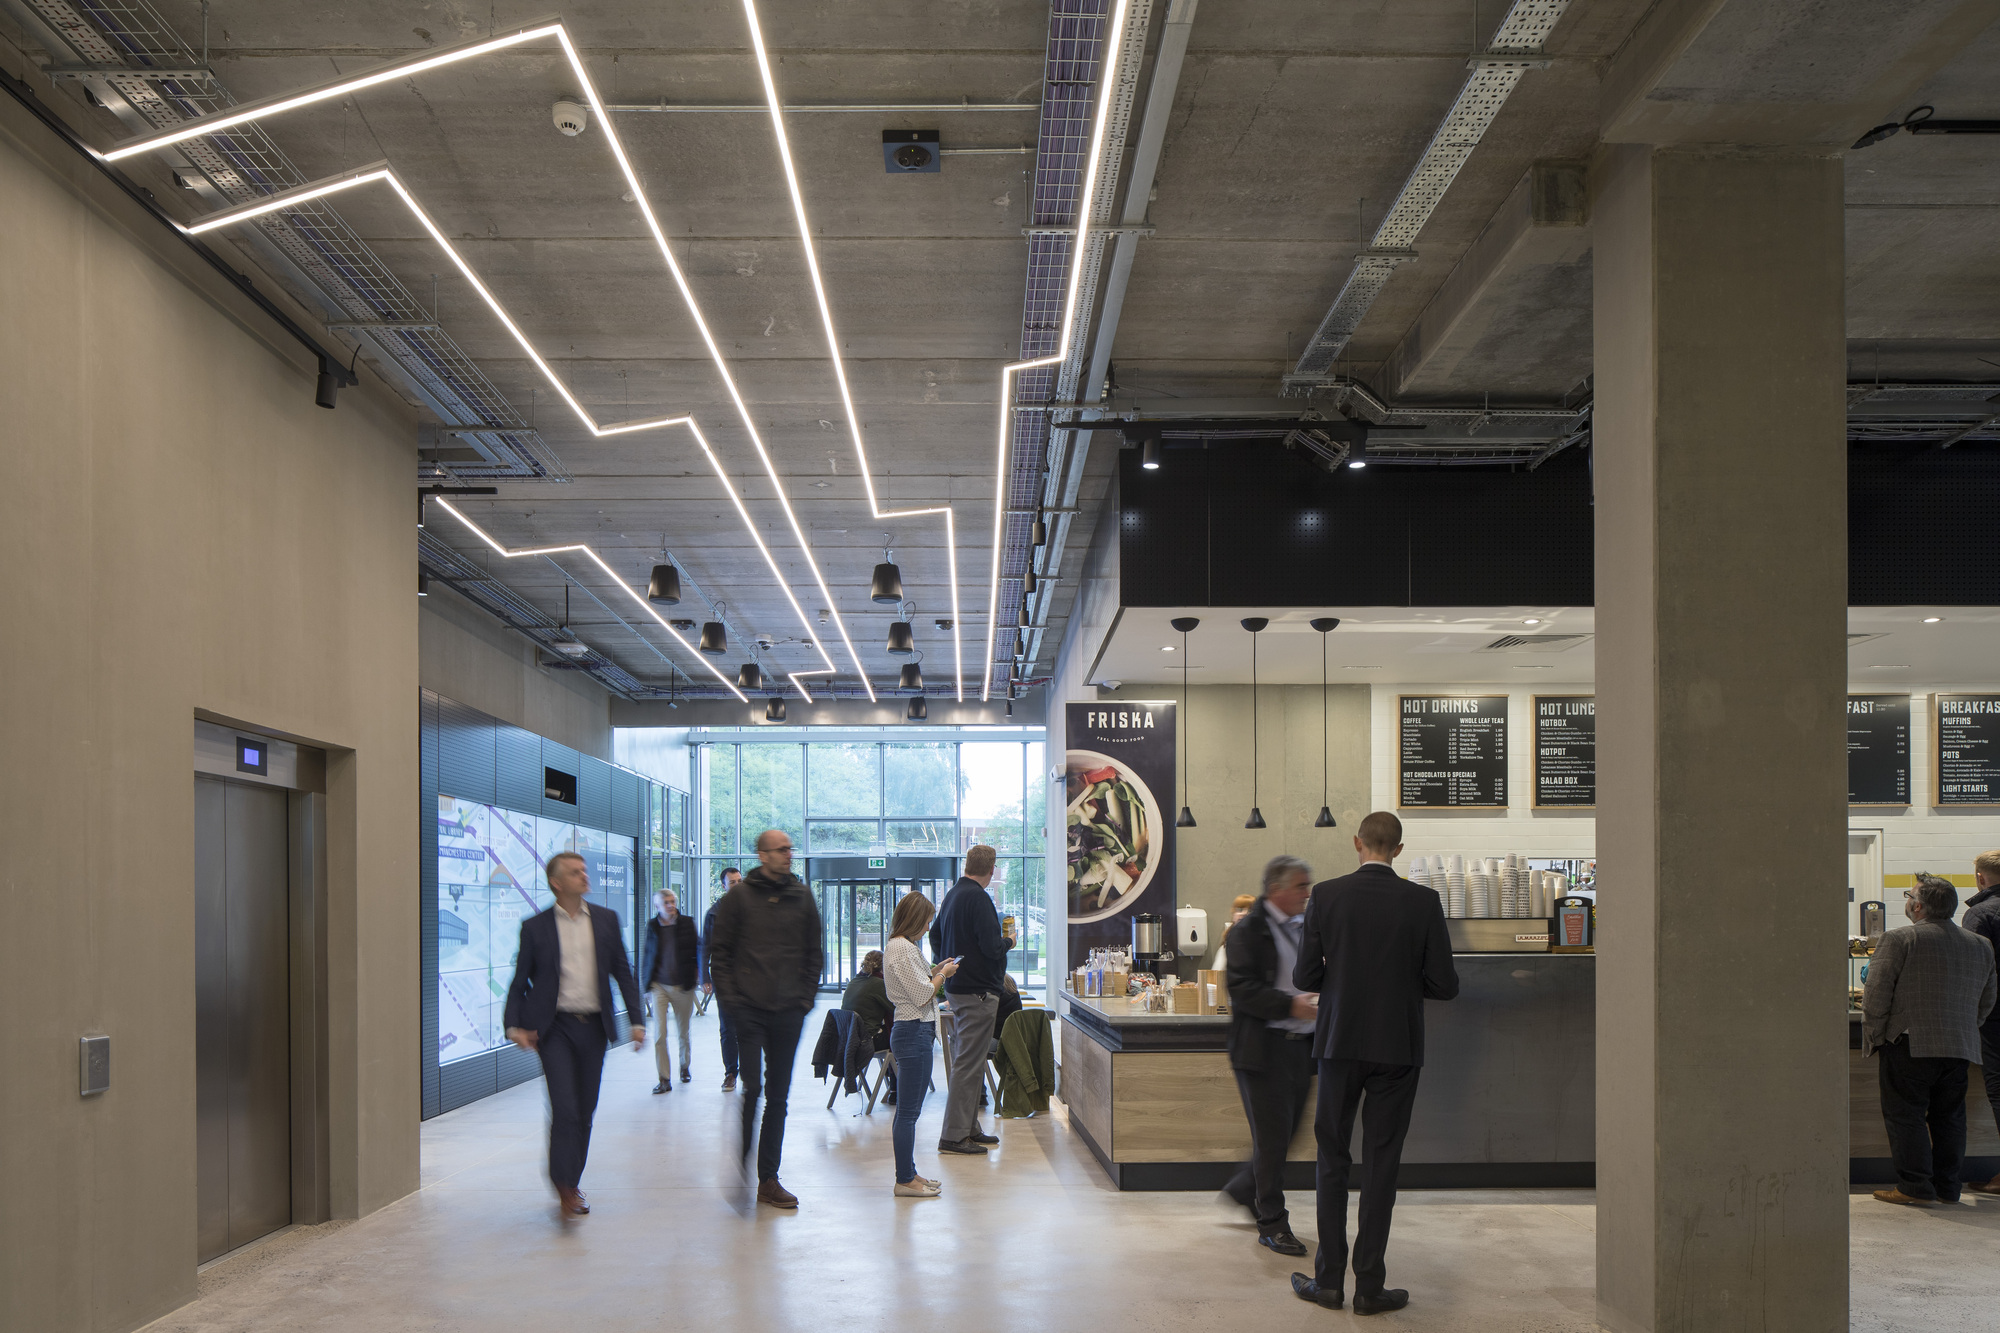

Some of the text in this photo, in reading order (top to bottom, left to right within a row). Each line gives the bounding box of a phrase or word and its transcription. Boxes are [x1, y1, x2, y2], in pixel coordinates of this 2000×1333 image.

[1403, 700, 1478, 713] HOT DRINKS
[1540, 703, 1595, 715] HOT LUNC
[1847, 701, 1874, 713] FAST
[1942, 701, 2000, 713] BREAKFAS
[1088, 712, 1154, 728] FRISKA
[1943, 717, 1971, 725] MUFFINS
[597, 862, 624, 875] to transport
